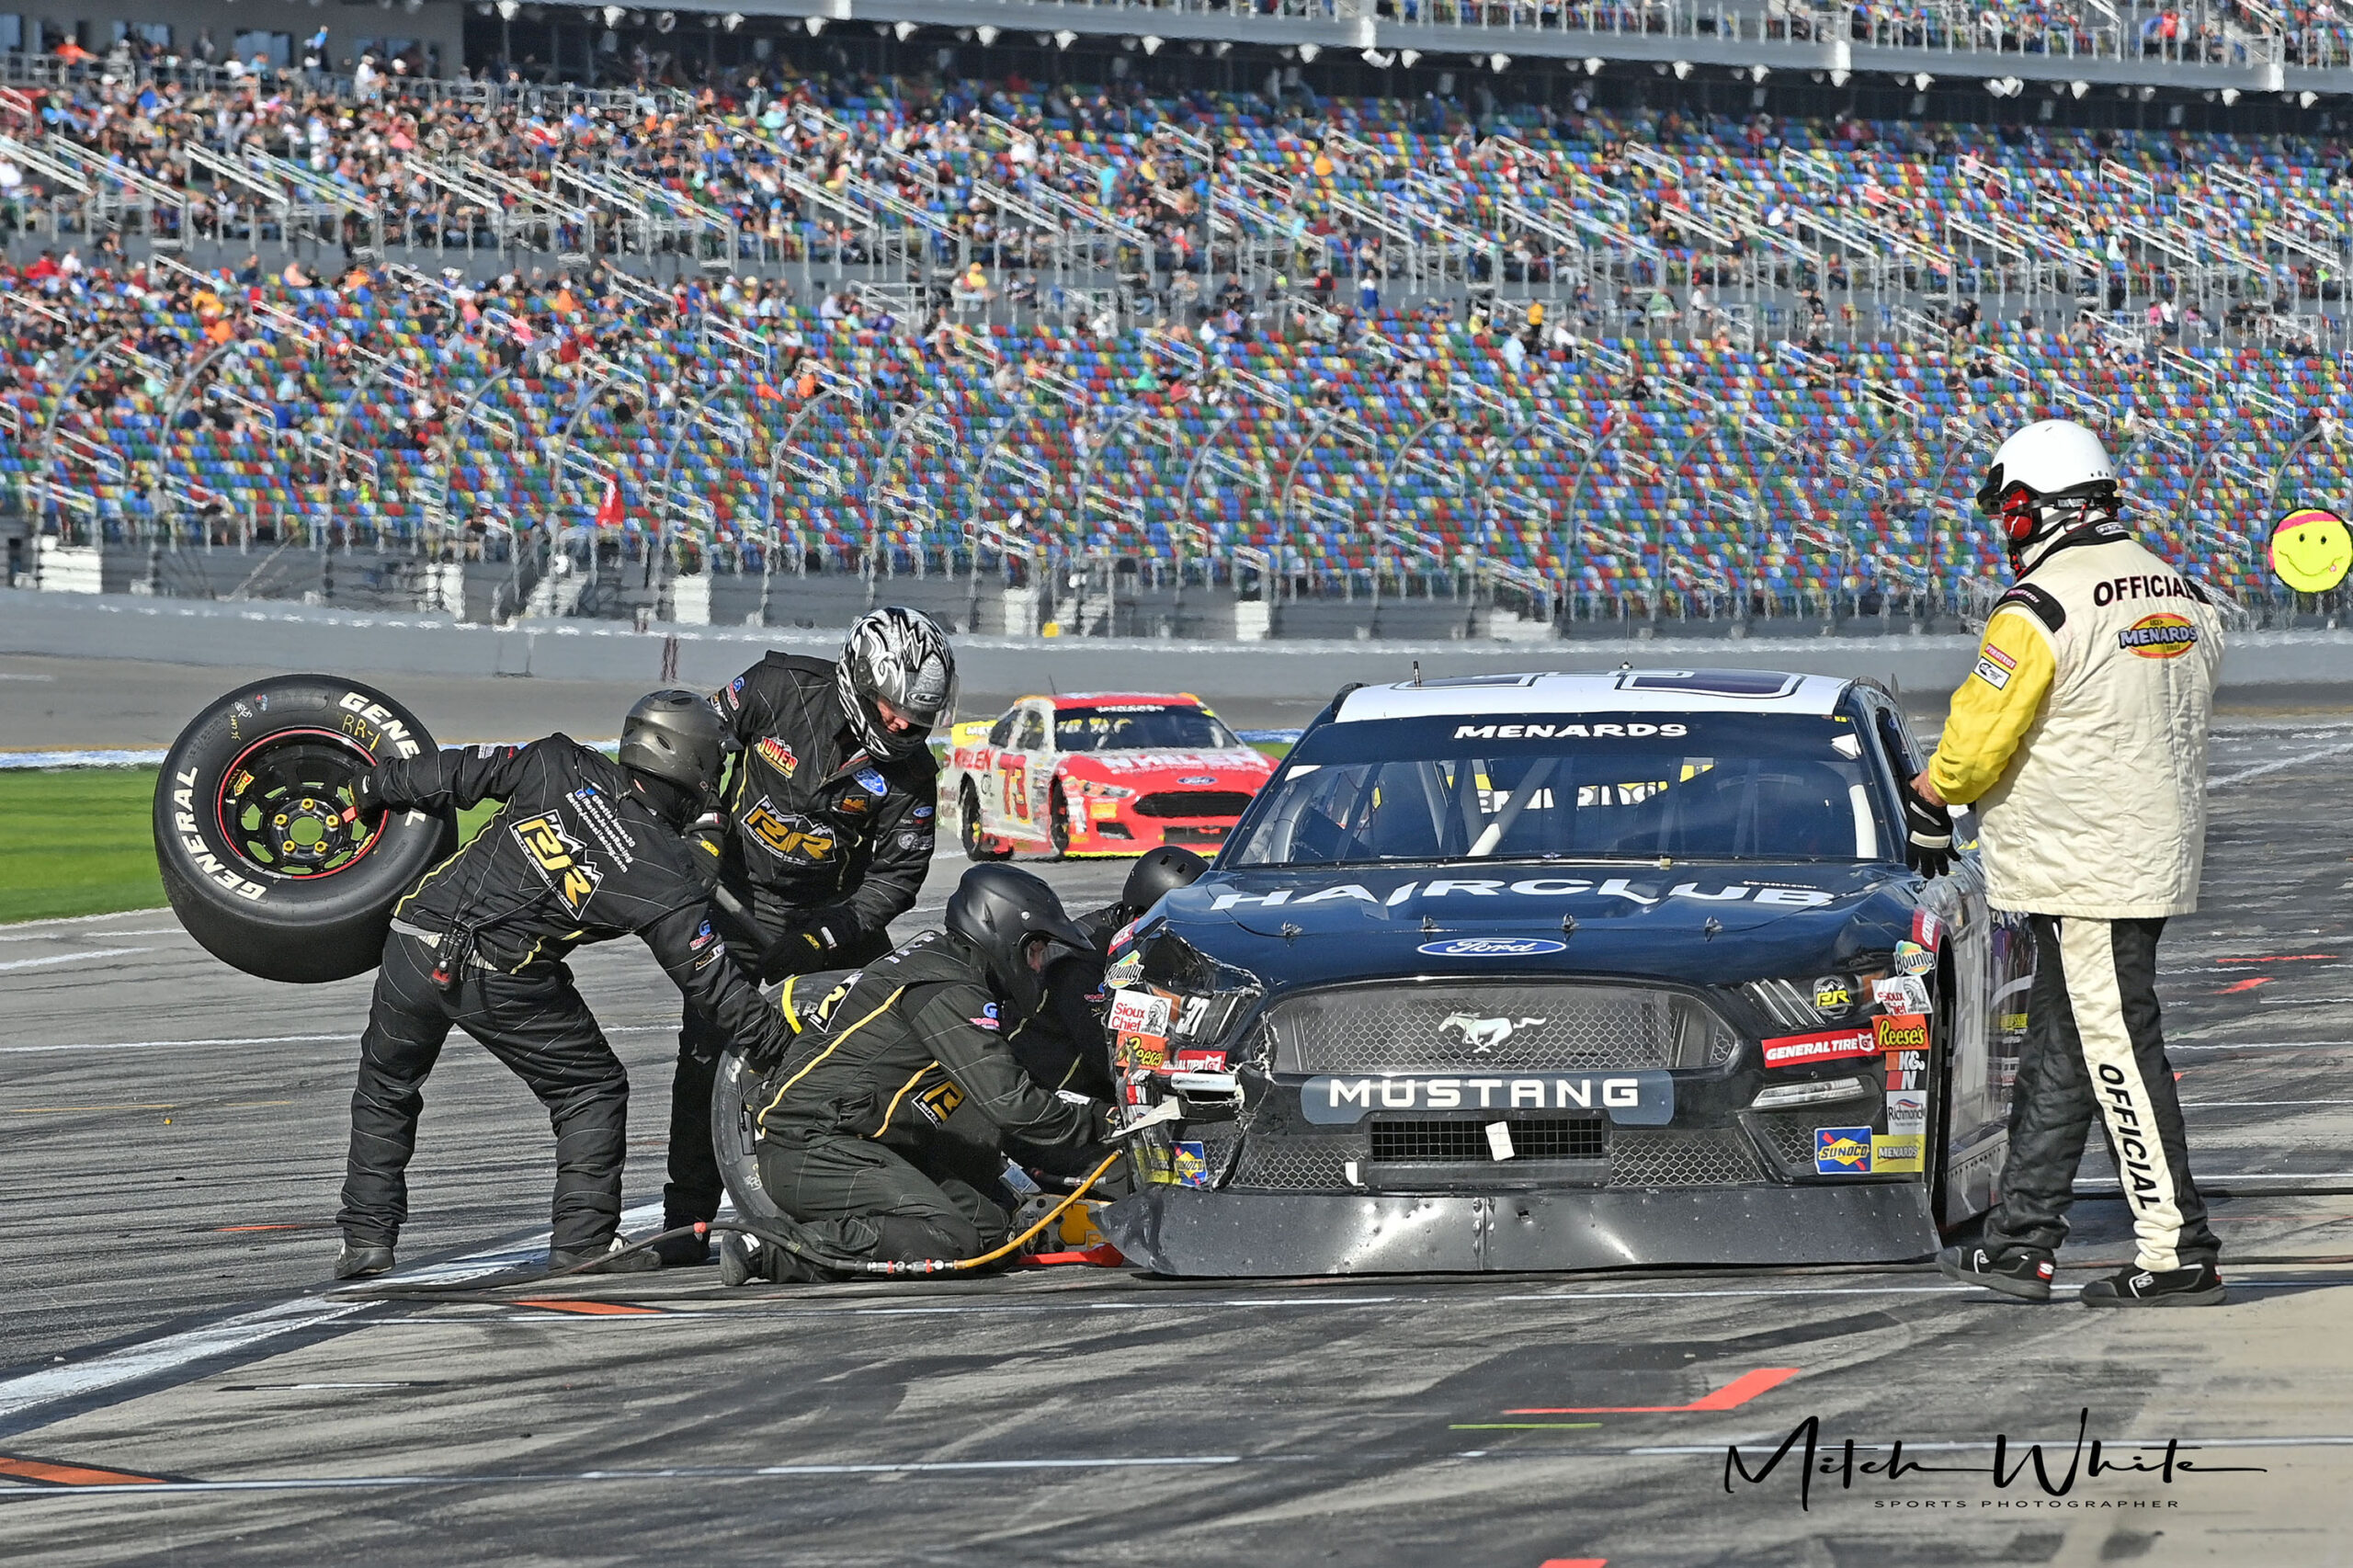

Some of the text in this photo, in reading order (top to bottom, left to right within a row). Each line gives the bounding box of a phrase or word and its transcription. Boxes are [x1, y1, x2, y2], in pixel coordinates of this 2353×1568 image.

[2093, 574, 2195, 608] OFFICIAL
[2119, 625, 2199, 649] MENARDS
[1454, 723, 1688, 740] MENARDS
[756, 738, 799, 771] JONES
[174, 767, 267, 901] GENERAL
[1210, 879, 1835, 911] HAIRCLUB
[1446, 938, 1538, 953] Ford
[1105, 963, 1145, 986] Bounty
[1895, 952, 1935, 975] Bounty
[1115, 1002, 1145, 1019] Sioux
[1111, 1016, 1142, 1032] Chief
[1879, 1020, 1926, 1047] Reese's
[1766, 1041, 1831, 1061] GENERAL
[1831, 1038, 1859, 1051] TIRE
[1329, 1077, 1640, 1108] MUSTANG
[1889, 1106, 1924, 1121] Richmond
[2098, 1063, 2161, 1210] OFFICIAL
[1819, 1144, 1869, 1160] SUNOCO
[1878, 1146, 1918, 1159] MENARDS
